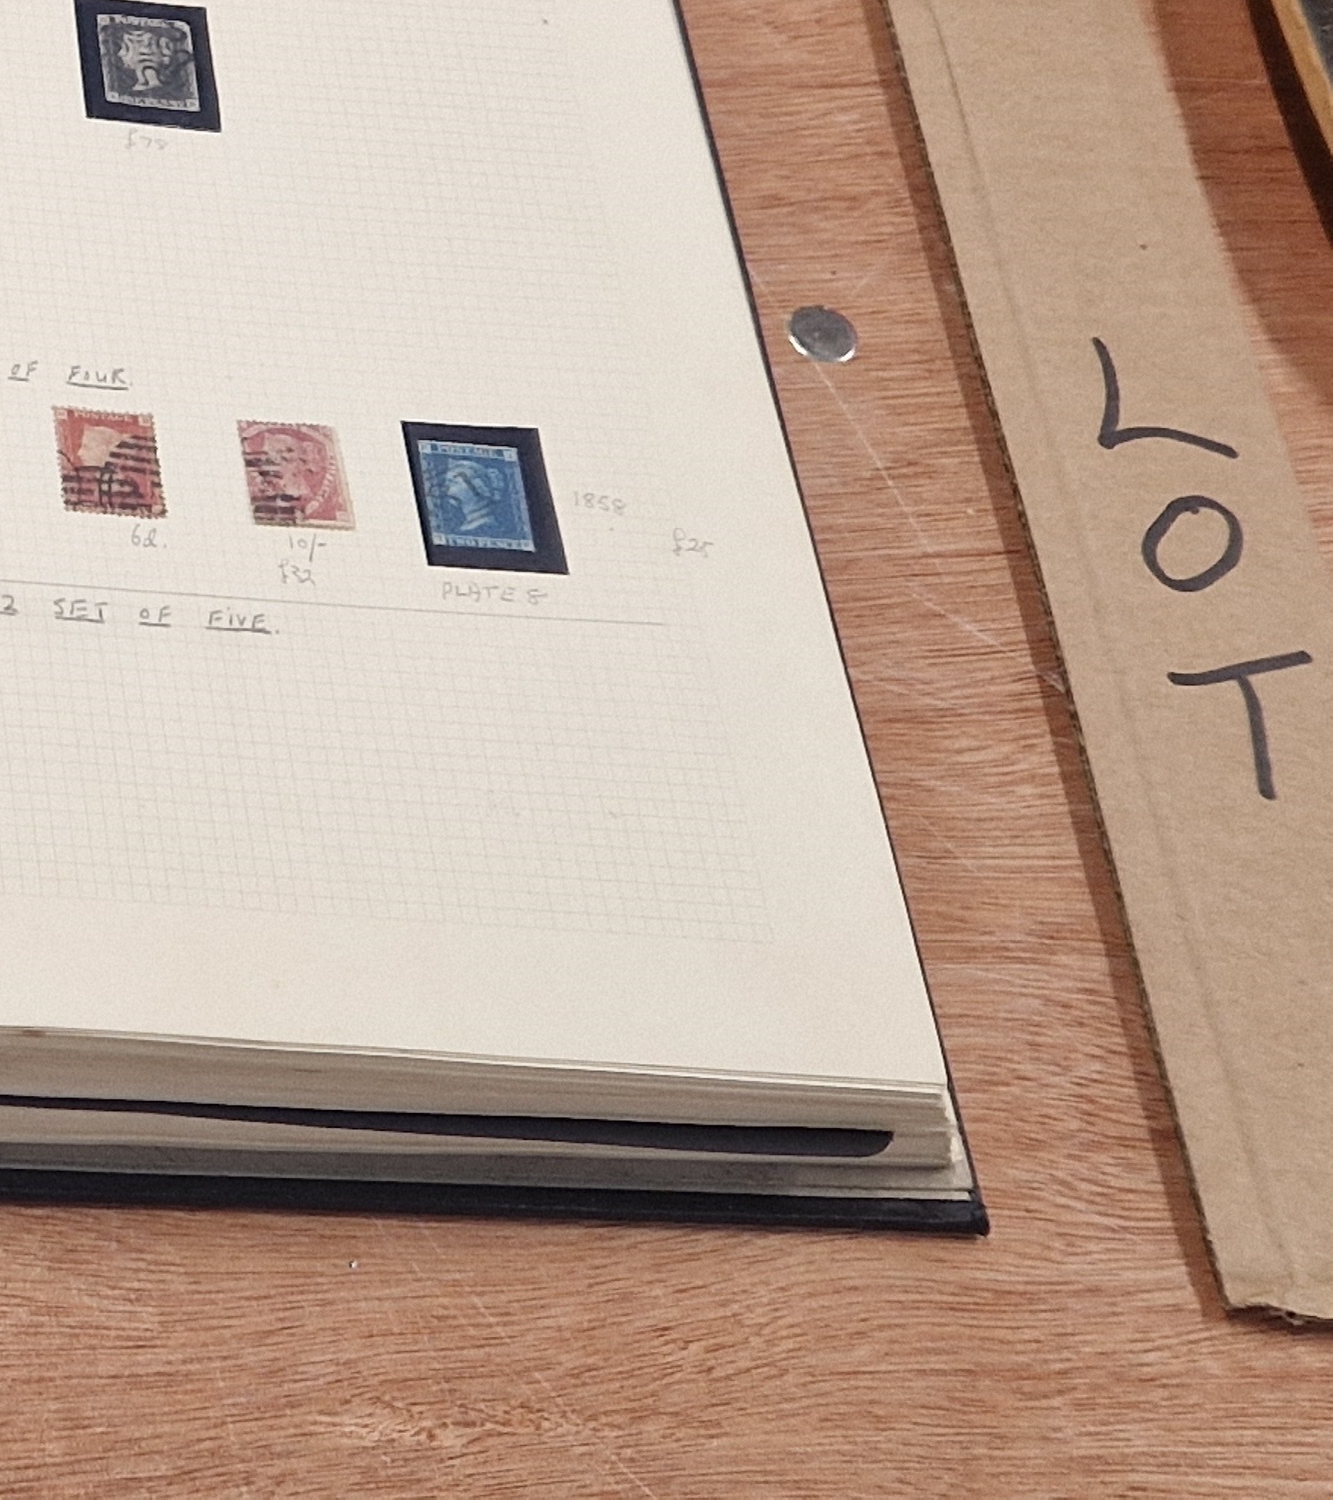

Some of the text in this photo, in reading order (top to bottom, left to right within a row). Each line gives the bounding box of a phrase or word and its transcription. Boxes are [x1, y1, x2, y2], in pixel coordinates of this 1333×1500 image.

[9, 361, 39, 380] OF
[1091, 336, 1312, 800] LOT
[442, 581, 516, 603] PLATE
[53, 598, 108, 623] SET
[139, 605, 172, 627] OF
